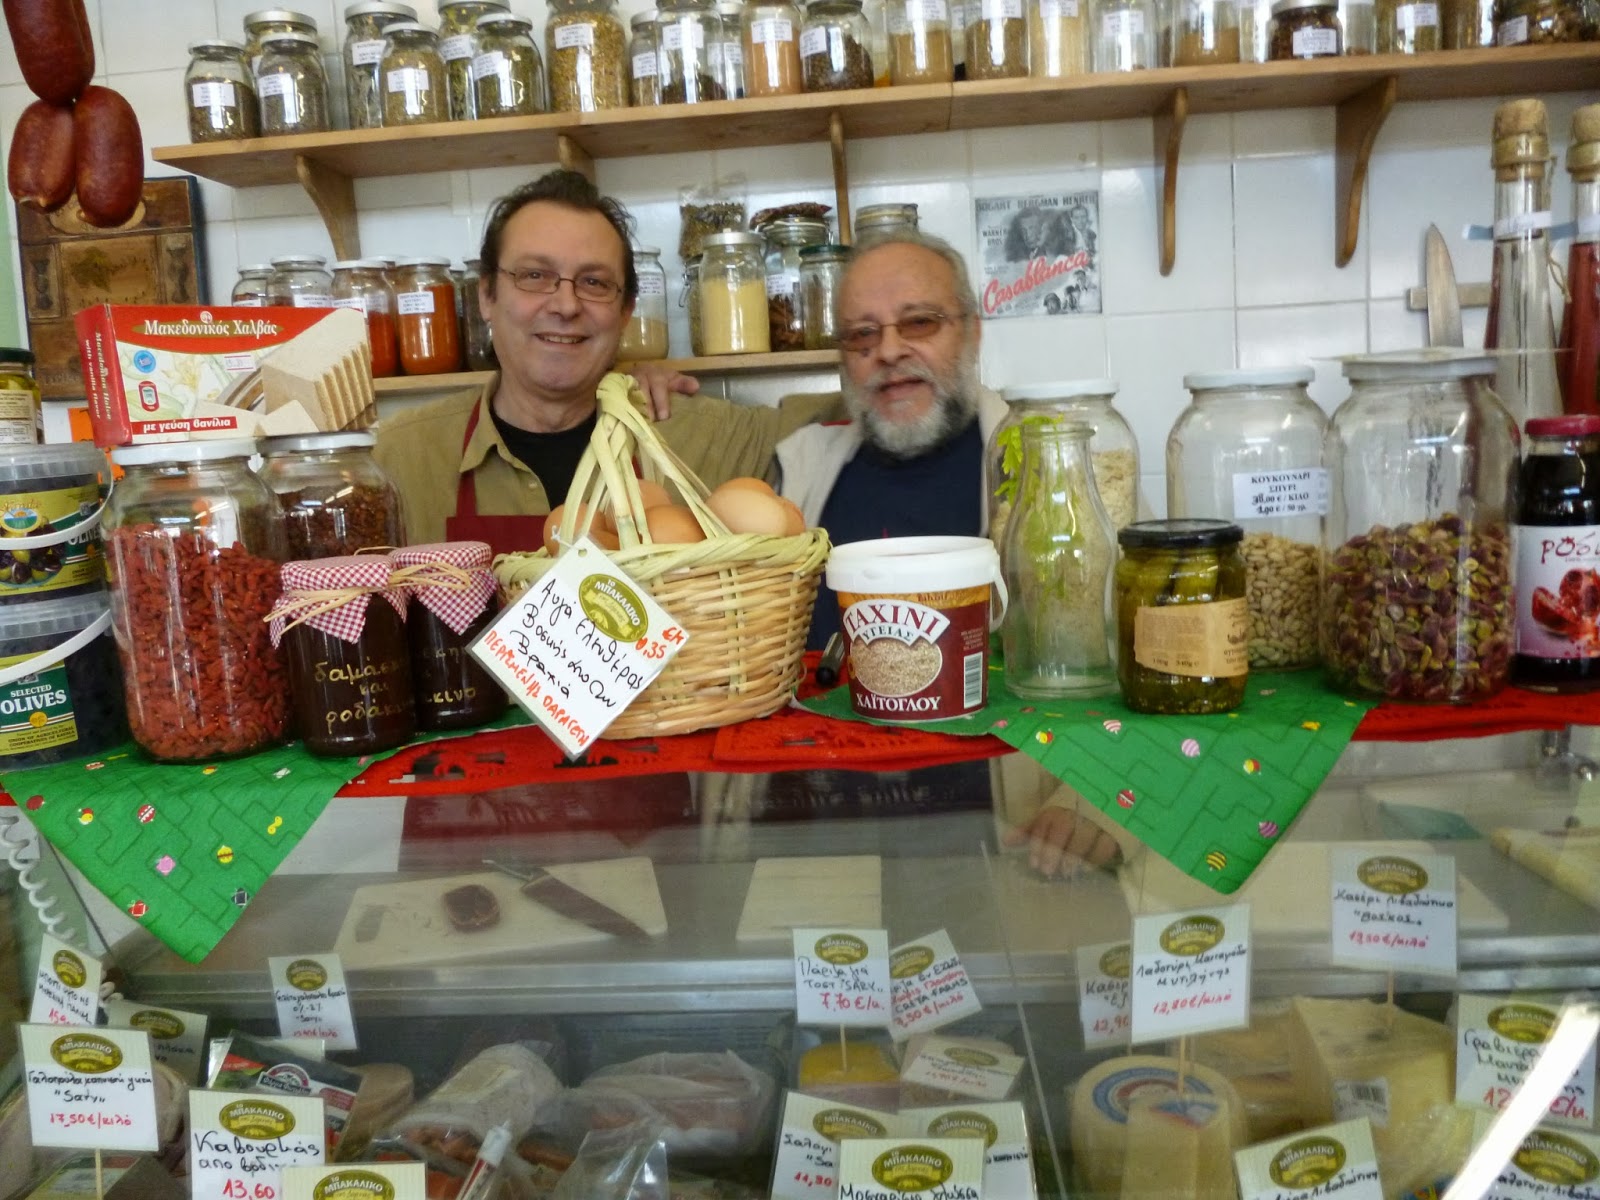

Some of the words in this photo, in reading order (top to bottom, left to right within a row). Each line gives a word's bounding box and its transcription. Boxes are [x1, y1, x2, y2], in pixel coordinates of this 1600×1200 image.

[983, 251, 1090, 315] Casablanca
[144, 318, 230, 337] Μακεδονικός
[233, 319, 278, 340] Χαλβάς
[89, 362, 97, 391] vanilla
[143, 423, 156, 433] με
[160, 420, 190, 433] γεύση
[193, 417, 231, 428] βανίλια
[1251, 472, 1310, 484] ΚΟΥΚΟΥΝΑΡΙ
[1288, 492, 1309, 501] ΚΙΛΟ
[594, 581, 641, 627] ΜΠΑΚΑΛΙΚΟ
[863, 626, 914, 642] ΥΓΕΙΑΣ
[635, 637, 667, 660] 0,35
[11, 684, 52, 697] SELECTED
[0, 689, 67, 714] OLIVES
[856, 692, 941, 712] ΧΑΪΤΟΓΛΟΥ
[1169, 924, 1217, 938] ΜΠΑΚΑΛΙΚΟ
[60, 1041, 112, 1054] ΜΠΑΚΑΛΙΚΟ
[229, 1107, 285, 1121] ΜΠΑΚΑΛΙΚΟ
[824, 1114, 878, 1134] ΜΠΑΚΑΛΙΚΟ
[936, 1120, 987, 1132] ΜΠΑΚΑΛΙΚΟ
[884, 1155, 942, 1168] ΜΠΑΚΑΛΙΚΟ
[1280, 1146, 1335, 1169] ΜΠΑΚΑΛΙΚΟ
[222, 1179, 275, 1200] 13,60
[324, 1181, 384, 1194] ΜΠΑΚΑΛΙΚΟ
